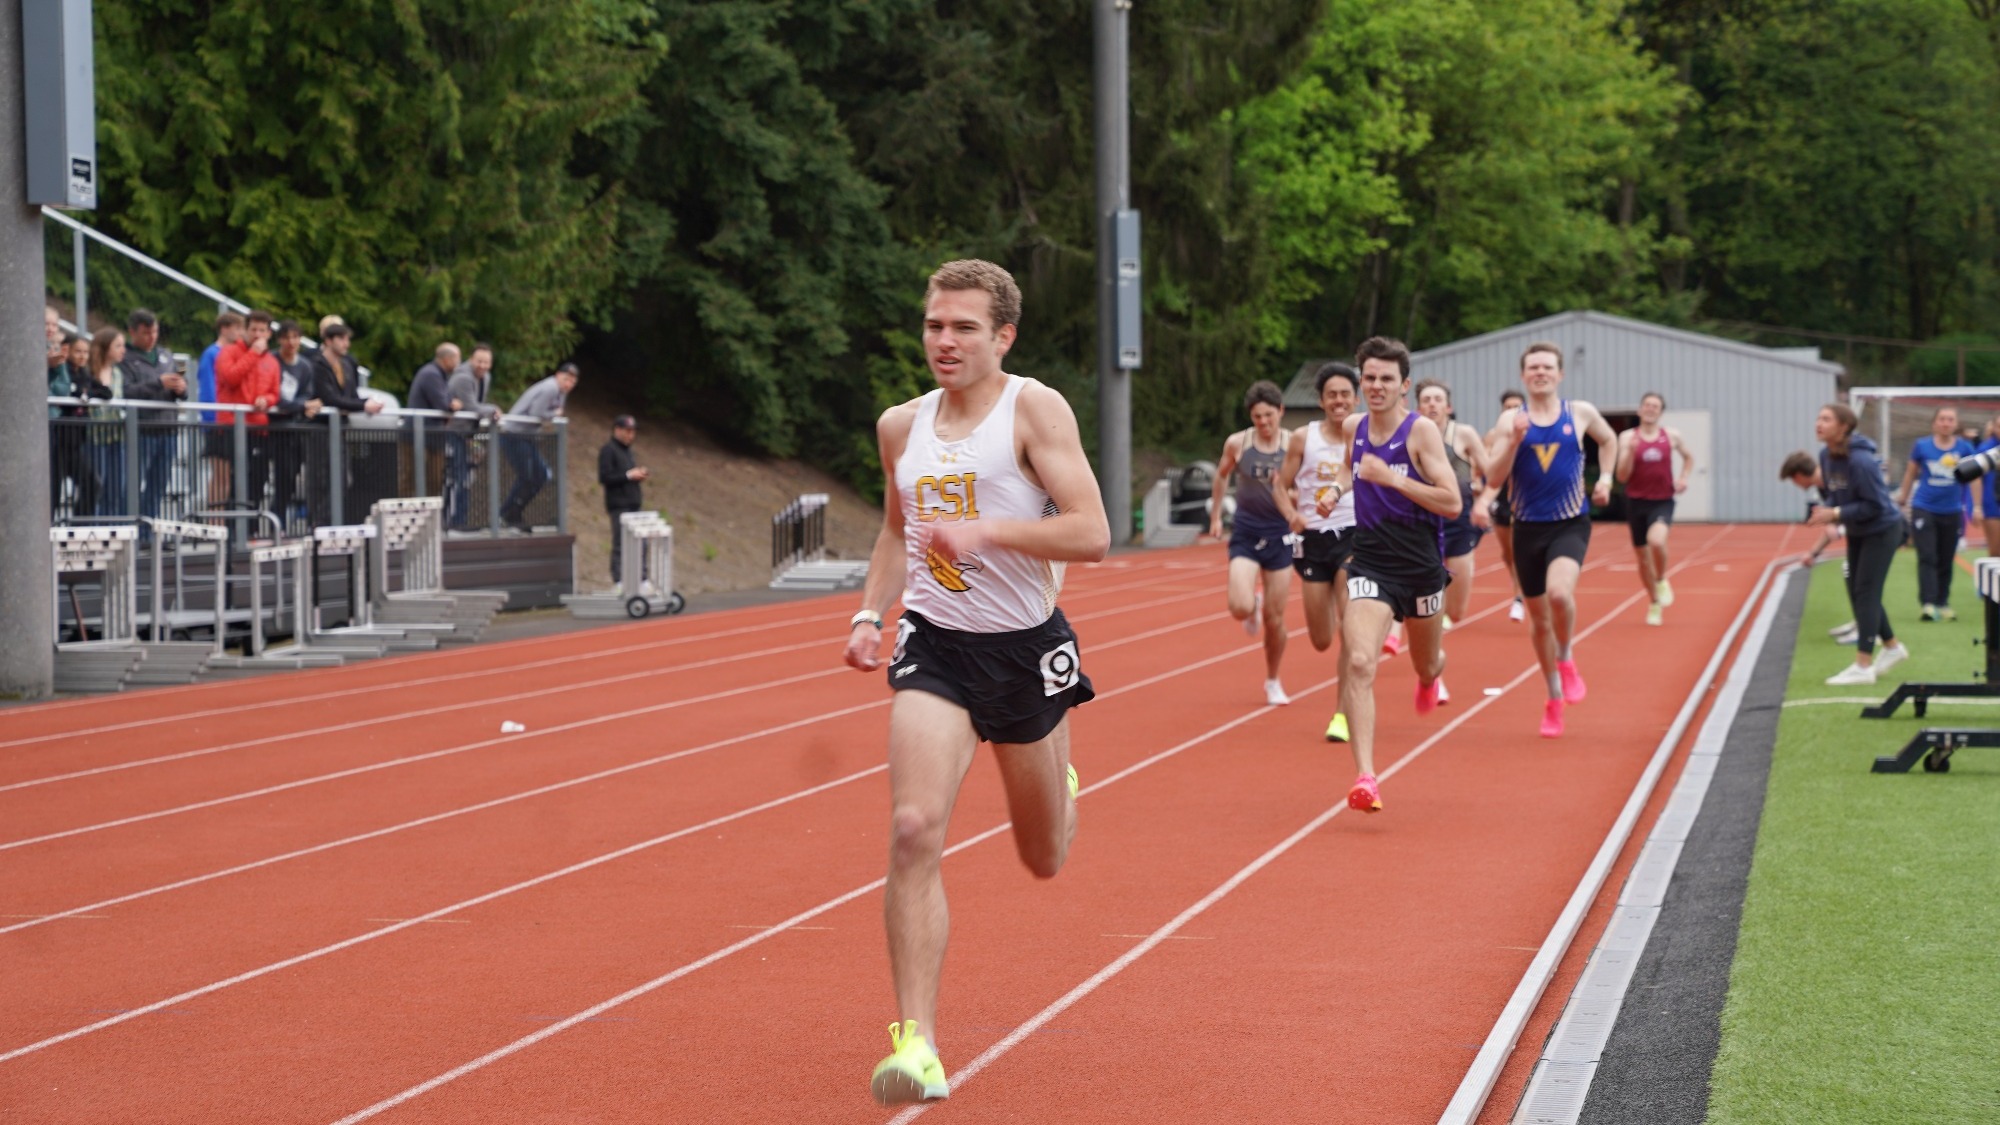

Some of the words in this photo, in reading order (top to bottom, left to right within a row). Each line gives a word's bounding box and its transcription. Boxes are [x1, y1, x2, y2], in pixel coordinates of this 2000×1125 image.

[1532, 442, 1560, 474] V
[917, 472, 979, 522] CSI
[1353, 578, 1372, 596] 10
[1421, 595, 1439, 614] 10
[1050, 650, 1074, 688] 9
